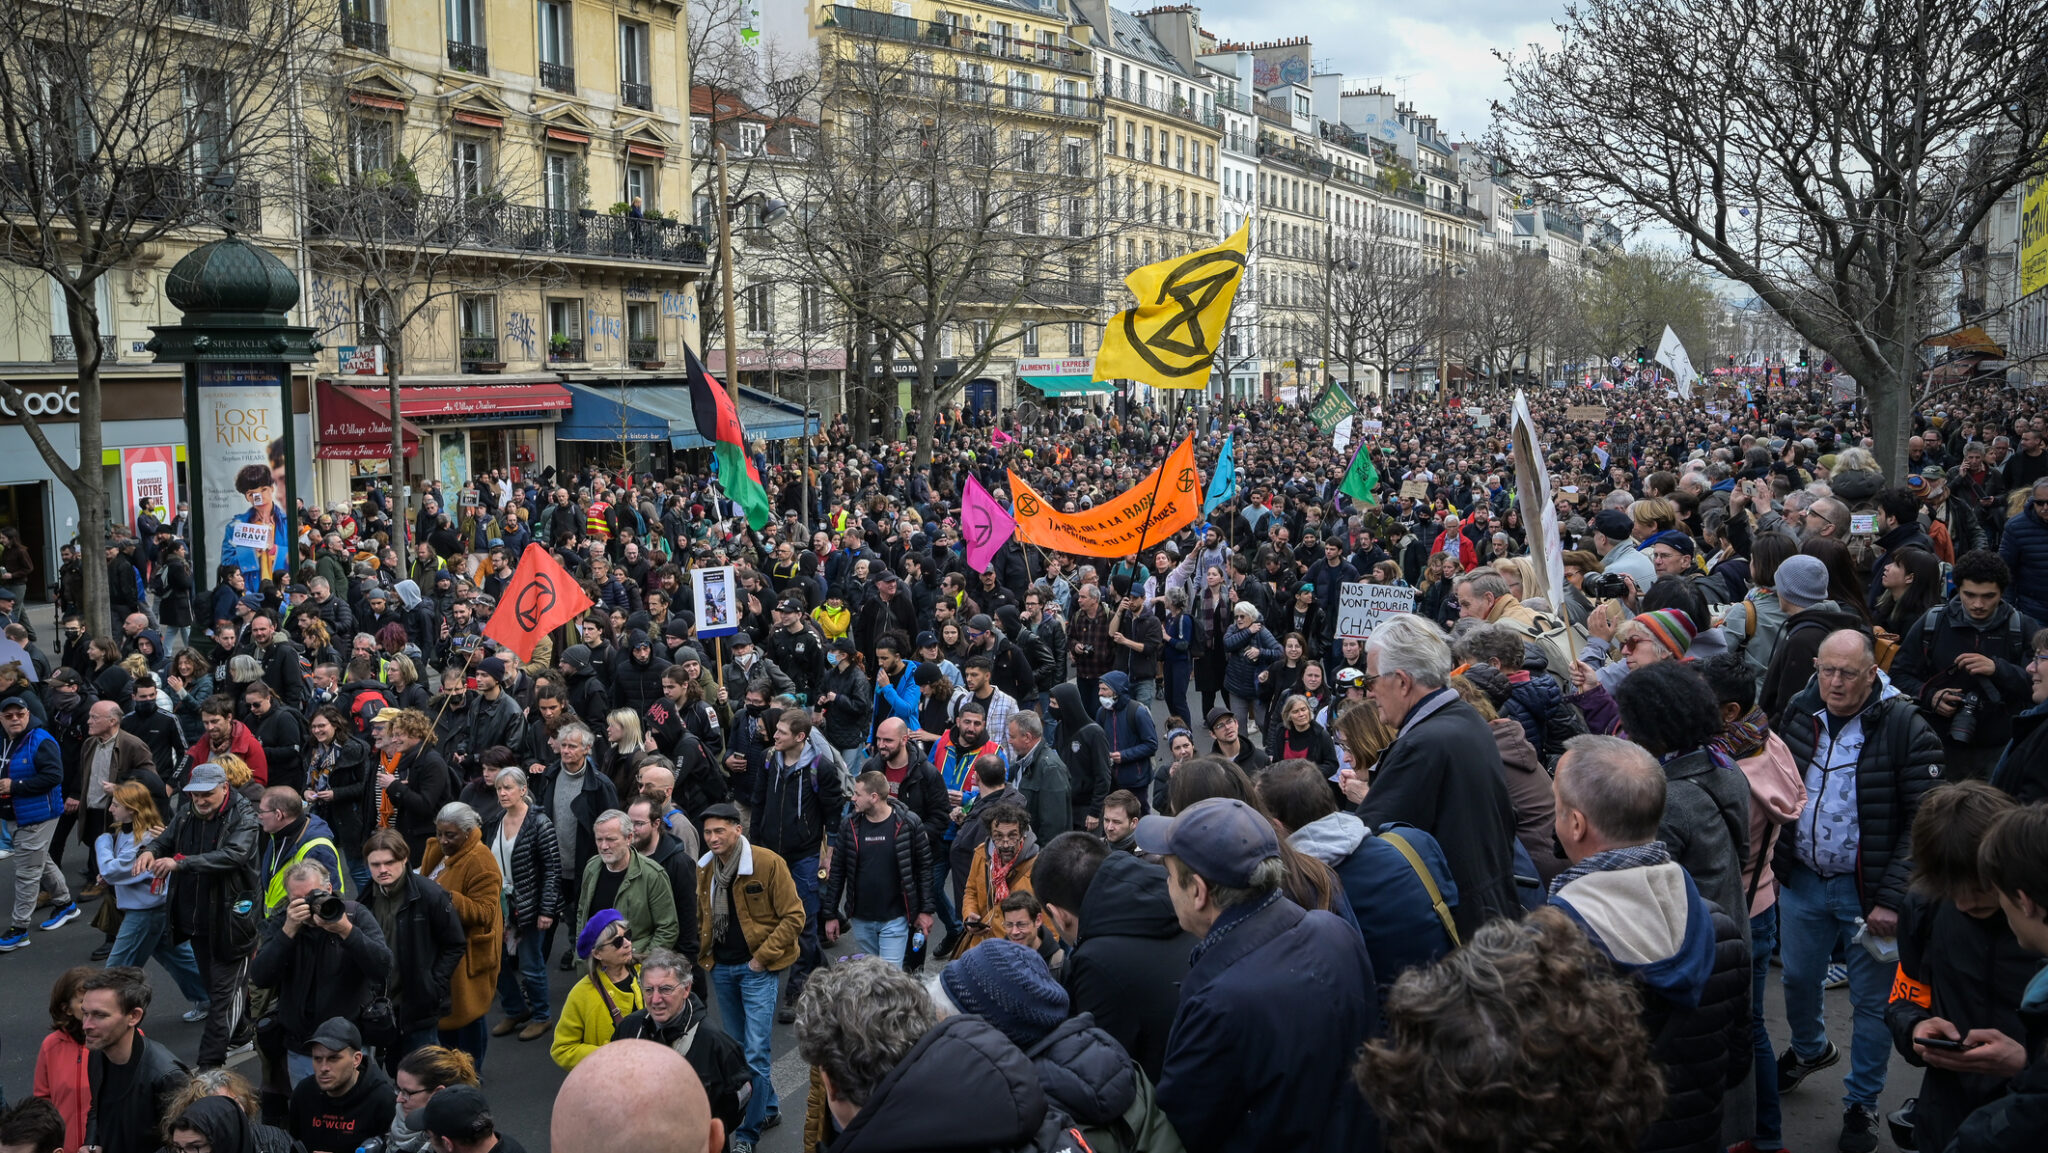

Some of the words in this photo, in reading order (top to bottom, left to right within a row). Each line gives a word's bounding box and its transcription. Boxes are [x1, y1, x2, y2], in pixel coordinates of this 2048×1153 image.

[212, 340, 268, 348] SPECTACLES
[1020, 363, 1051, 371] ALIMENTS
[454, 402, 474, 411] Village
[215, 408, 269, 426] LOST
[325, 424, 338, 436] Au
[340, 423, 366, 437] Village
[368, 421, 393, 434] Italien
[216, 425, 270, 448] KING
[354, 444, 374, 456] Fine
[138, 484, 163, 497] VOTRE
[1108, 517, 1123, 527] LA
[234, 532, 266, 541] GRAVE
[1120, 532, 1136, 542] LA
[1342, 584, 1364, 597] NOS
[1371, 586, 1414, 600] DARONS
[1341, 598, 1370, 608] VONT
[1366, 609, 1380, 618] AU
[312, 1116, 356, 1130] foward
